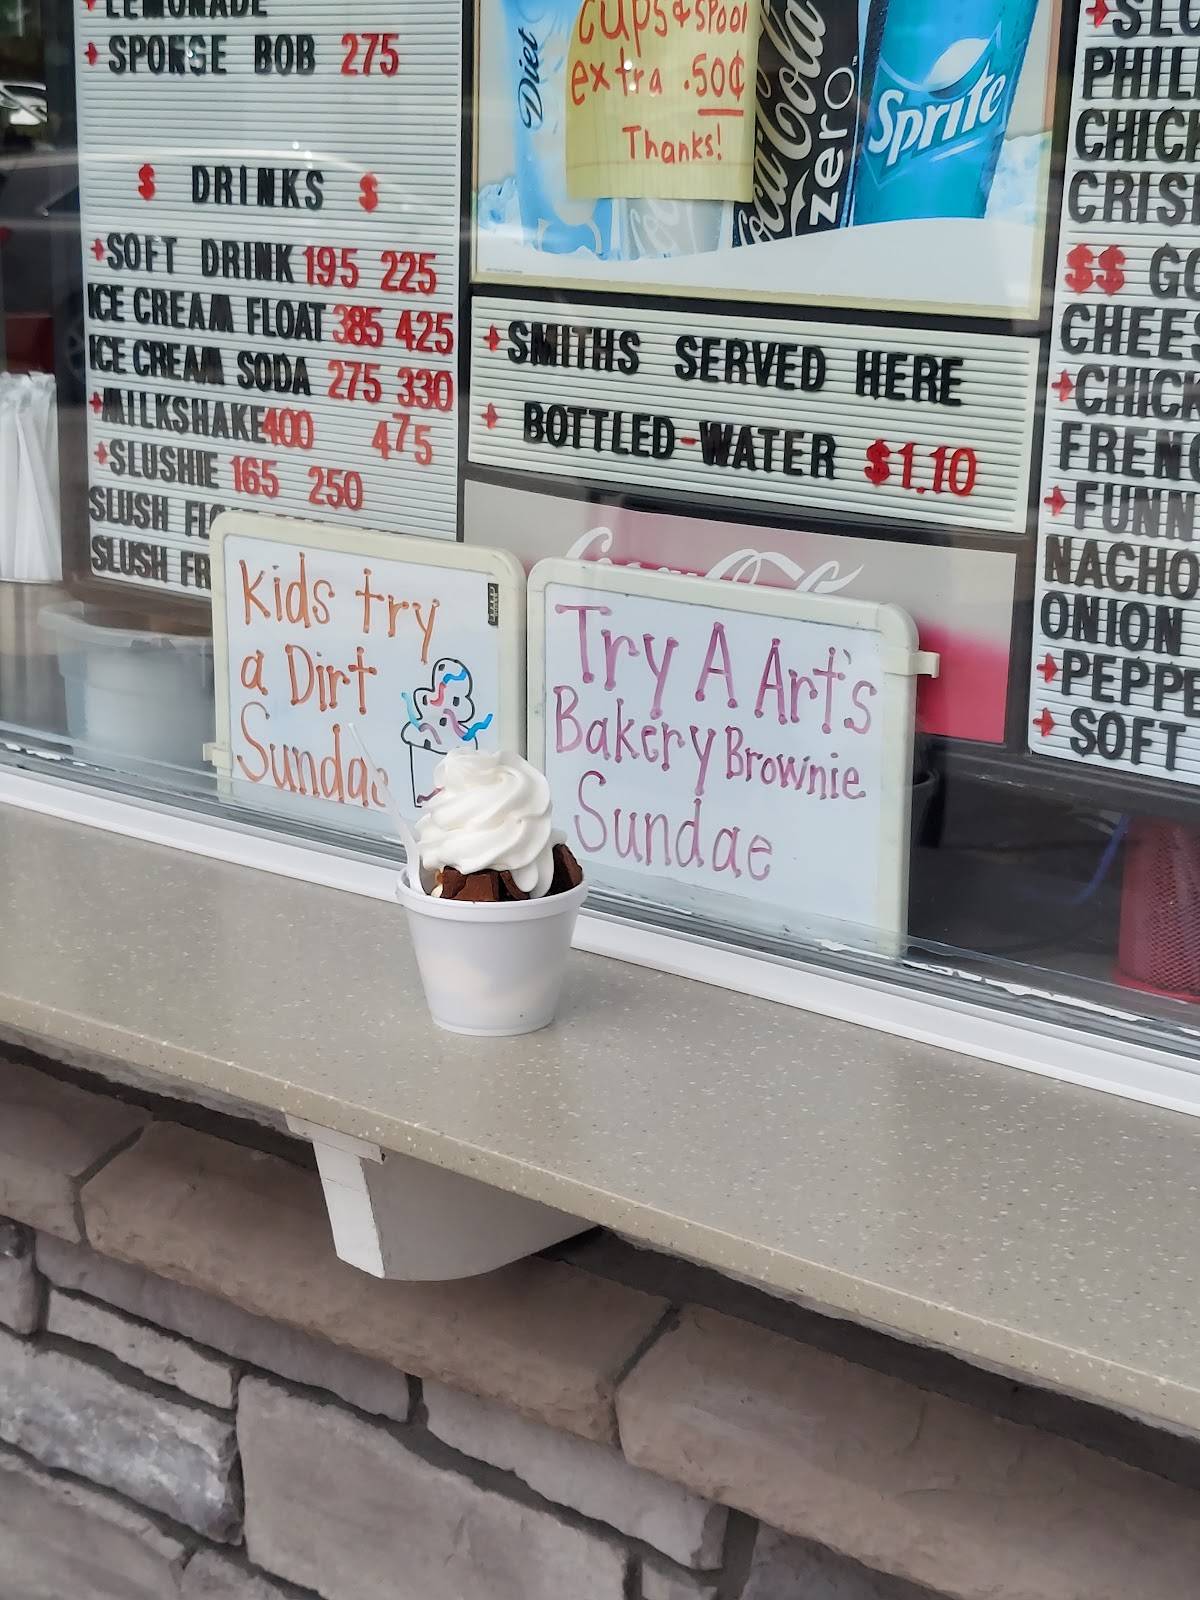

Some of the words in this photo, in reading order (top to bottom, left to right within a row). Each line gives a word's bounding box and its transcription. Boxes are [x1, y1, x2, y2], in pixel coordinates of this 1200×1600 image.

[254, 34, 315, 76] BOB
[341, 33, 400, 77] 275
[517, 27, 543, 130] Diet
[571, 47, 662, 106] extra
[684, 50, 745, 102] .50¢
[1081, 46, 1200, 101] PHIL
[622, 123, 722, 164] Thanks!
[809, 66, 856, 226] zero
[867, 59, 1007, 168] Sprite
[191, 165, 324, 211] DRINKS
[107, 233, 177, 274] SOFT
[202, 239, 296, 283] DRINK
[303, 246, 359, 289] 195
[380, 250, 437, 295] 225
[88, 283, 124, 323] ICE
[133, 287, 234, 334] CREAM
[246, 298, 327, 343] FLOAT
[332, 303, 384, 348] 385
[395, 310, 454, 355] 425
[1061, 303, 1200, 361] CHEE
[88, 334, 127, 373] ICE
[133, 340, 225, 386] CREAM
[236, 350, 312, 396] SODA
[327, 359, 382, 404] 275
[397, 367, 454, 411] 330
[508, 320, 640, 375] SMITHS
[674, 335, 827, 393] SERVED
[855, 350, 964, 406] HERE
[102, 388, 267, 444] MILKSHAKE
[261, 407, 315, 450] 400
[371, 413, 433, 466] 475
[109, 438, 219, 489] SLUSHIE
[230, 456, 280, 498] 165
[308, 466, 363, 511] 250
[863, 438, 978, 497] $1.10
[89, 486, 168, 532] SLUSH
[1074, 481, 1196, 542] FUNN
[91, 535, 168, 583] SLUSH
[181, 551, 211, 590] FR
[1044, 535, 1200, 600] NACHO
[239, 552, 336, 629] Kids
[355, 568, 440, 665] try
[1040, 590, 1183, 657] ONION
[240, 649, 269, 696] a
[284, 643, 378, 714] Dirt
[555, 604, 680, 720] Try
[695, 621, 738, 709] A
[753, 638, 877, 734] Art's
[553, 685, 716, 797] Bakery
[725, 724, 867, 801] Brownie
[1070, 707, 1187, 772] SOFT
[573, 769, 774, 881] Sundae
